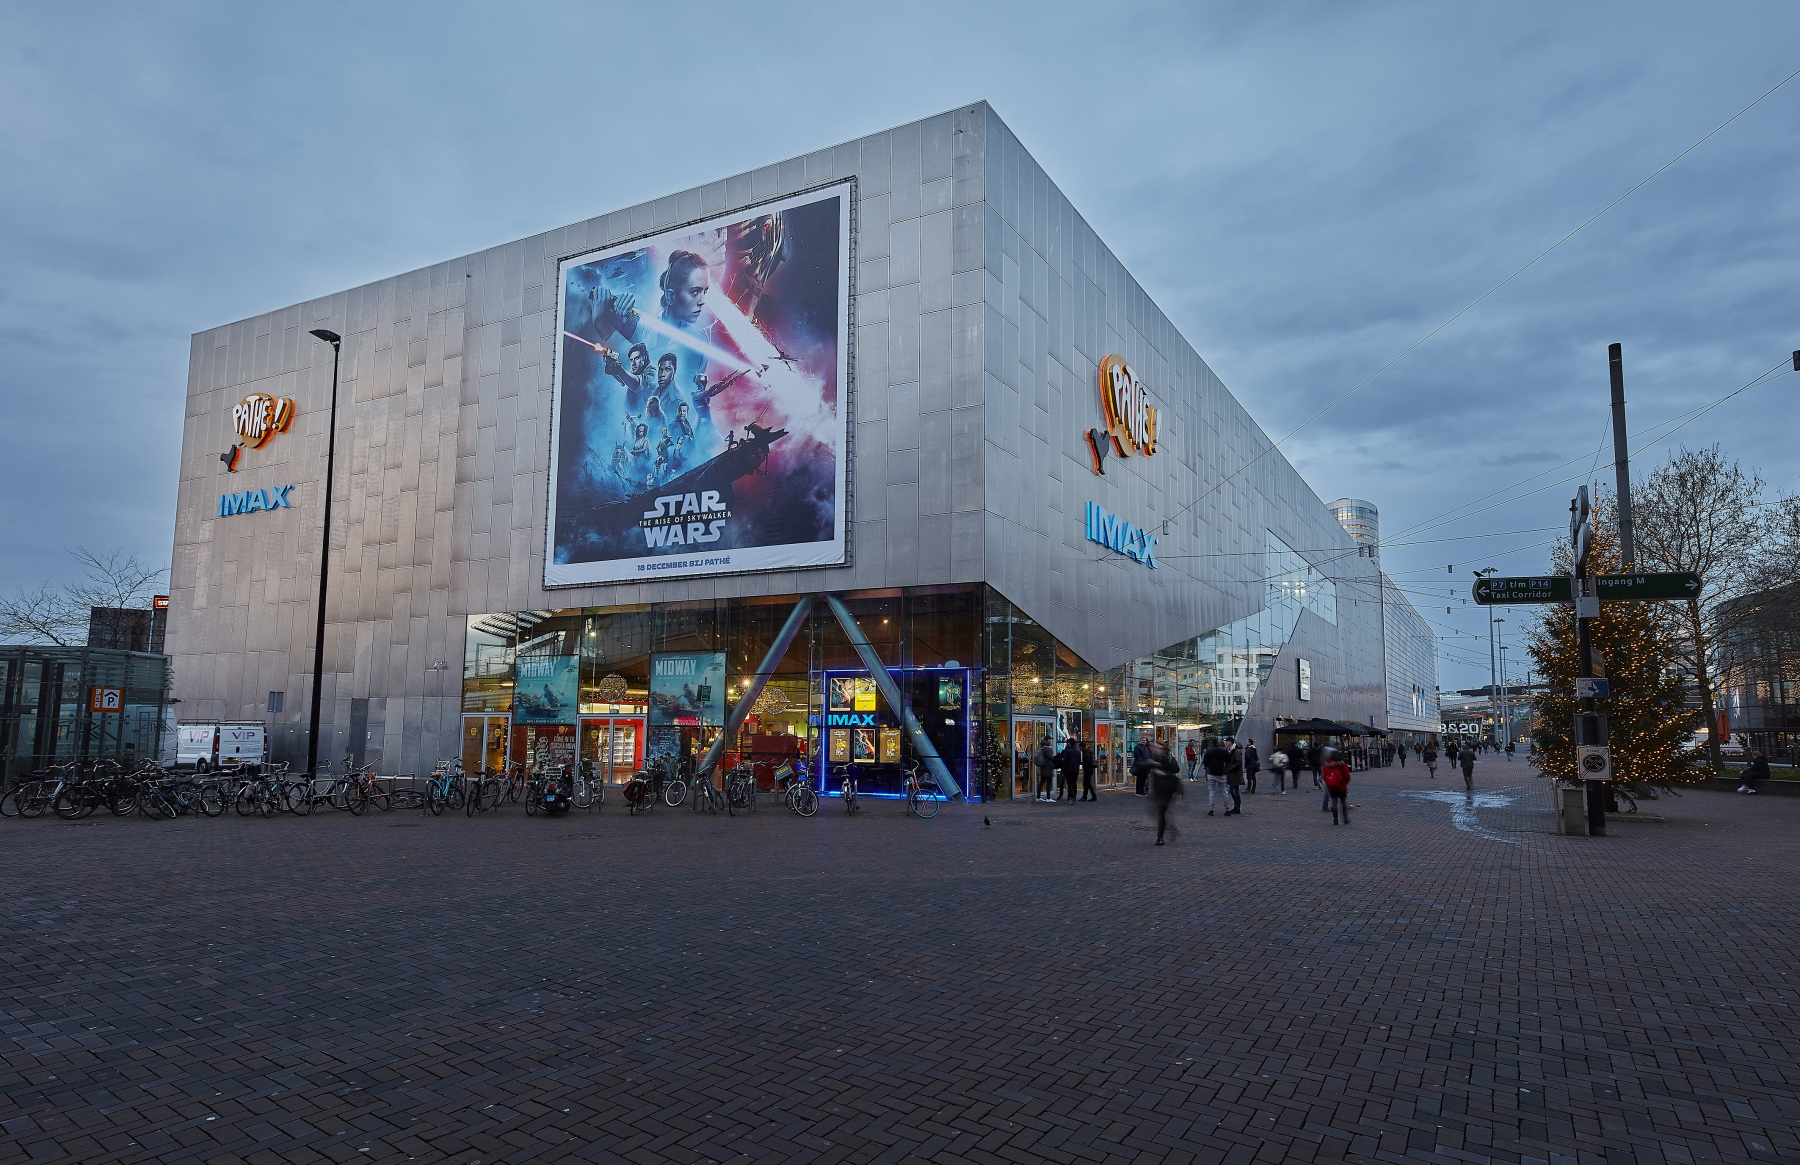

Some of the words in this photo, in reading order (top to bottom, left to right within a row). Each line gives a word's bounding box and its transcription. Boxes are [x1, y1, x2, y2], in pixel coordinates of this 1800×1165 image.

[217, 484, 294, 517] IMAX
[643, 489, 726, 519] STAR
[638, 519, 652, 527] THE
[654, 517, 671, 525] RISE
[687, 510, 732, 522] SKYWALKER
[643, 519, 726, 548] WARS
[1086, 501, 1159, 569] IMAX
[637, 564, 646, 572] 18
[646, 561, 688, 570] DECEMBER
[689, 559, 703, 568] BIJ
[705, 555, 731, 566] PATHÉ
[1598, 578, 1633, 587] Ingang
[1636, 577, 1645, 585] M
[1490, 591, 1509, 599] Taxi
[1512, 590, 1552, 599] Corridor
[521, 660, 555, 677] MIDWAY
[655, 659, 697, 676] MIDWAY
[828, 714, 875, 726] IMAX
[189, 730, 210, 743] VIP
[231, 731, 256, 740] VIP
